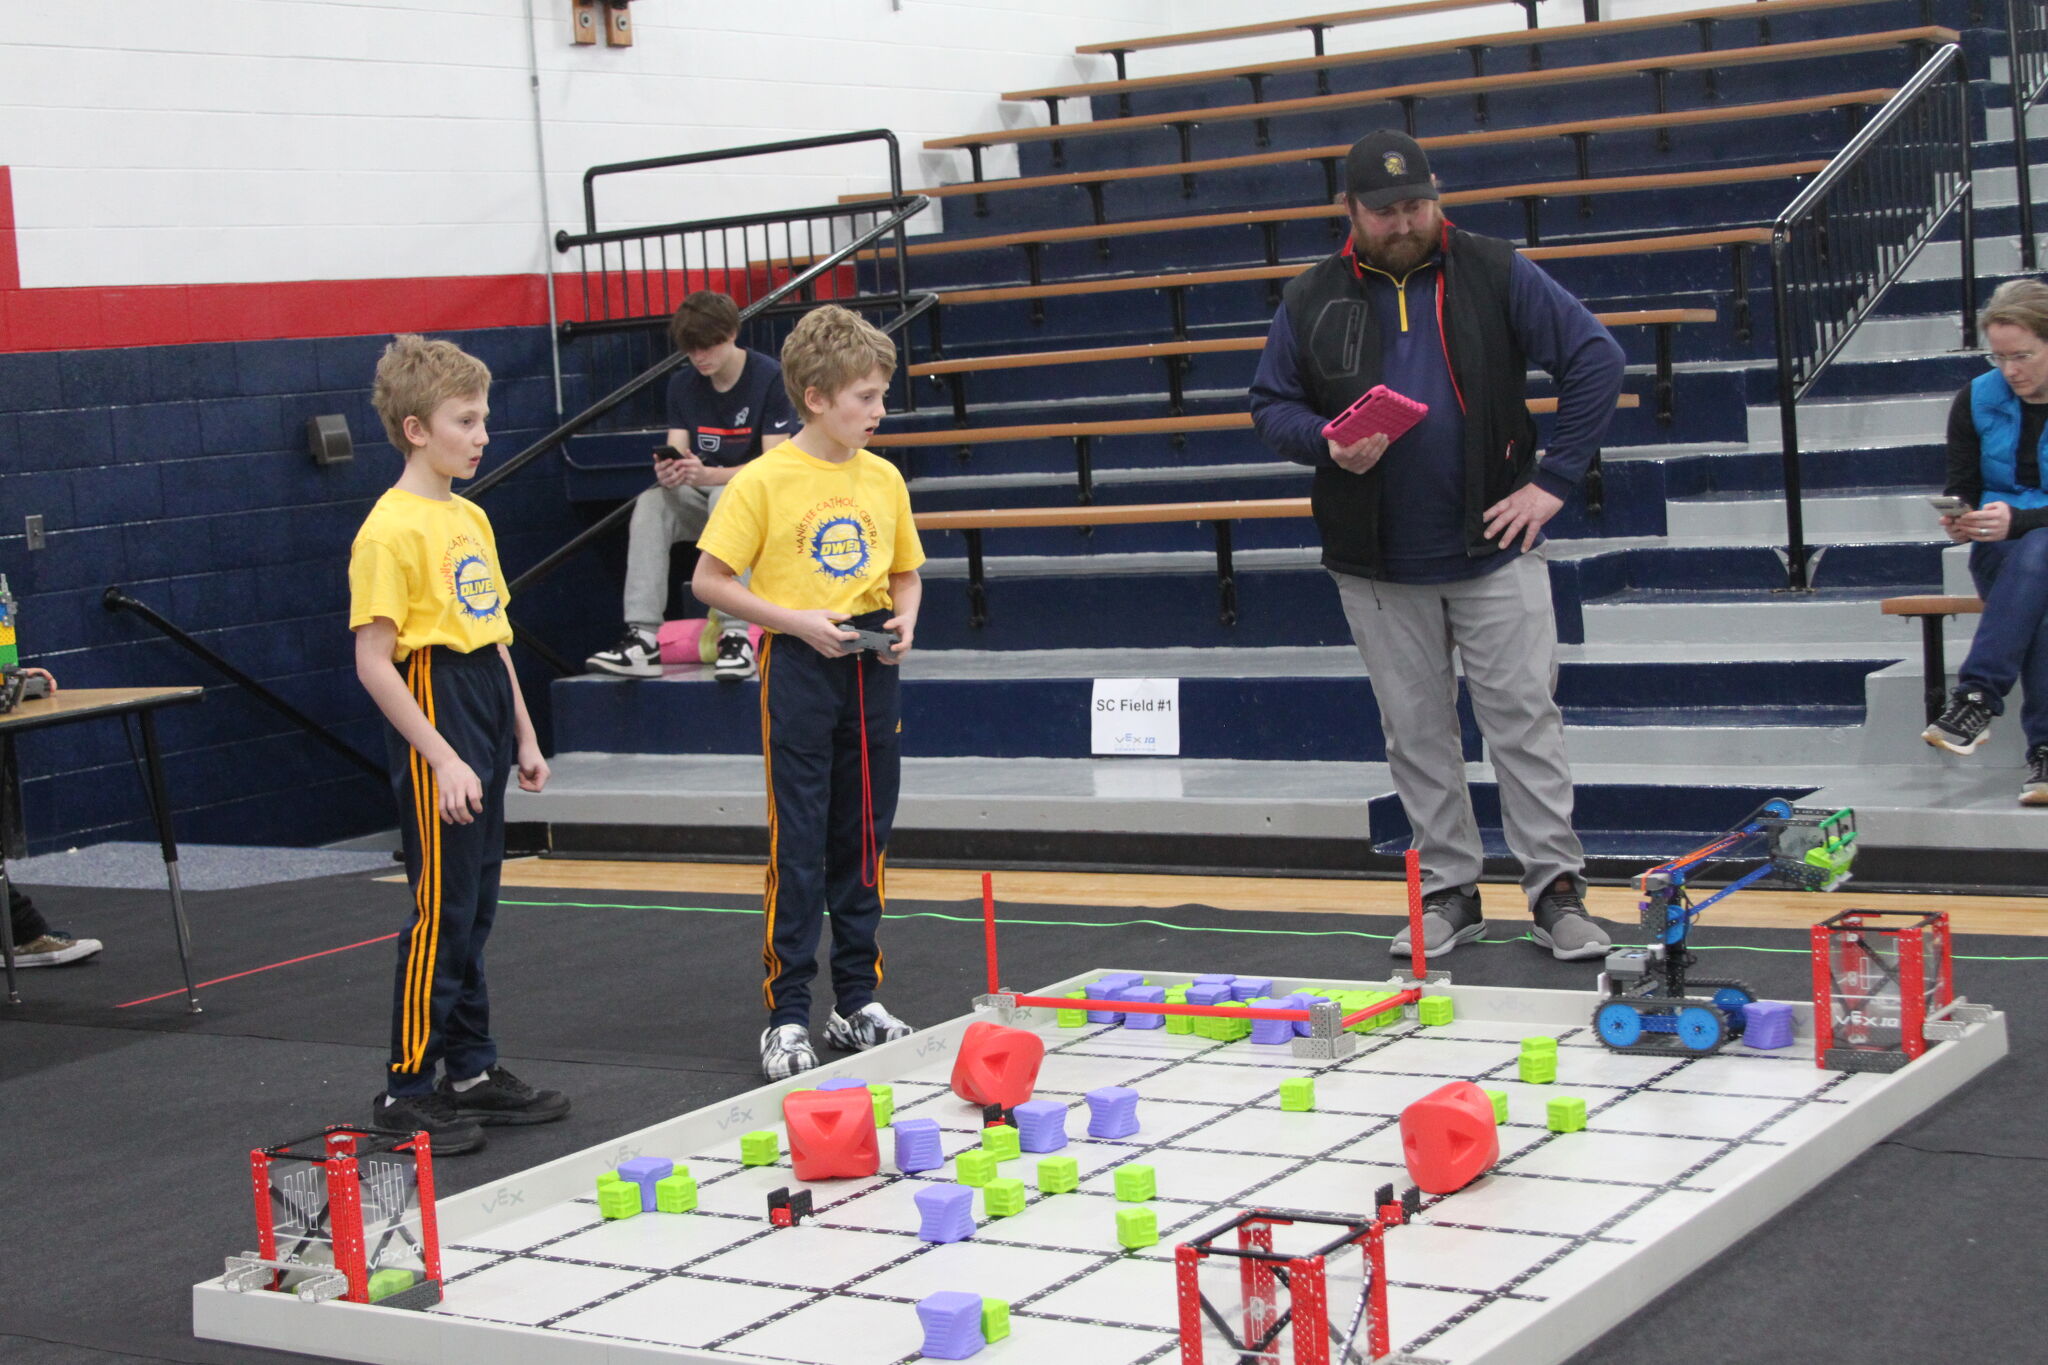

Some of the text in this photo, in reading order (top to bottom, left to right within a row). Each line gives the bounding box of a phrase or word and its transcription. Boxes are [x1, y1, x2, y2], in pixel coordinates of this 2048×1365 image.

[816, 496, 859, 511] CATHOL
[460, 580, 495, 597] OLIVE
[1096, 699, 1172, 711] SC Field #1
[1835, 1010, 1877, 1027] VEX
[916, 1035, 948, 1058] VEX
[717, 1105, 754, 1130] VEX
[481, 1186, 525, 1214] VEX
[366, 1247, 402, 1270] VEX
